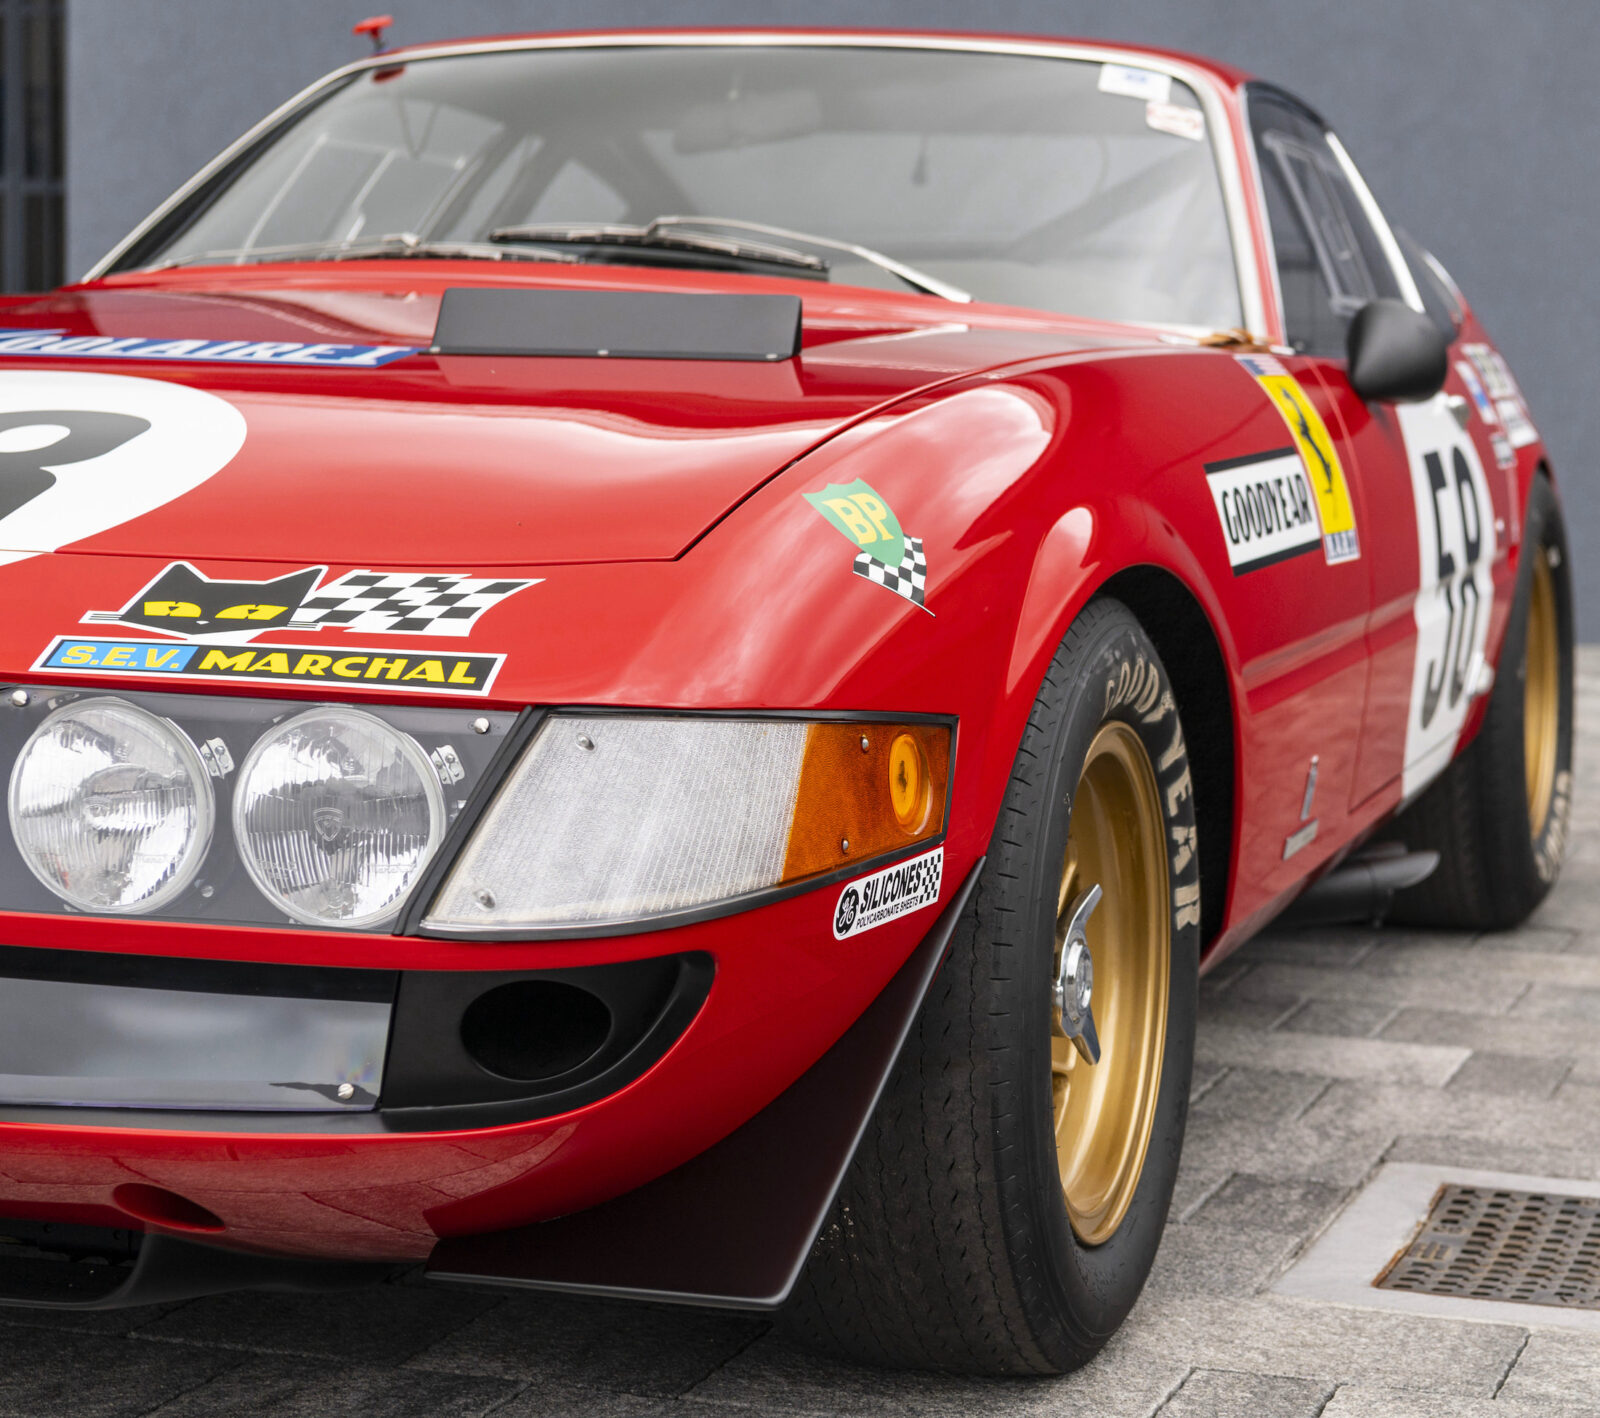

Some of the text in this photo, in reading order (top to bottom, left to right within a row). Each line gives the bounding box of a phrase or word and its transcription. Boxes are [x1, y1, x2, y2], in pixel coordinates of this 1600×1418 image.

[821, 493, 895, 545] BP
[1222, 473, 1313, 545] GOODYEAR
[1423, 446, 1482, 731] 58
[60, 644, 477, 685] S.E.V. MARCHAL
[1101, 655, 1200, 931] GOODYEAR
[855, 894, 920, 930] POLYCARBONATE SHEETS
[860, 860, 923, 915] SILICONES
